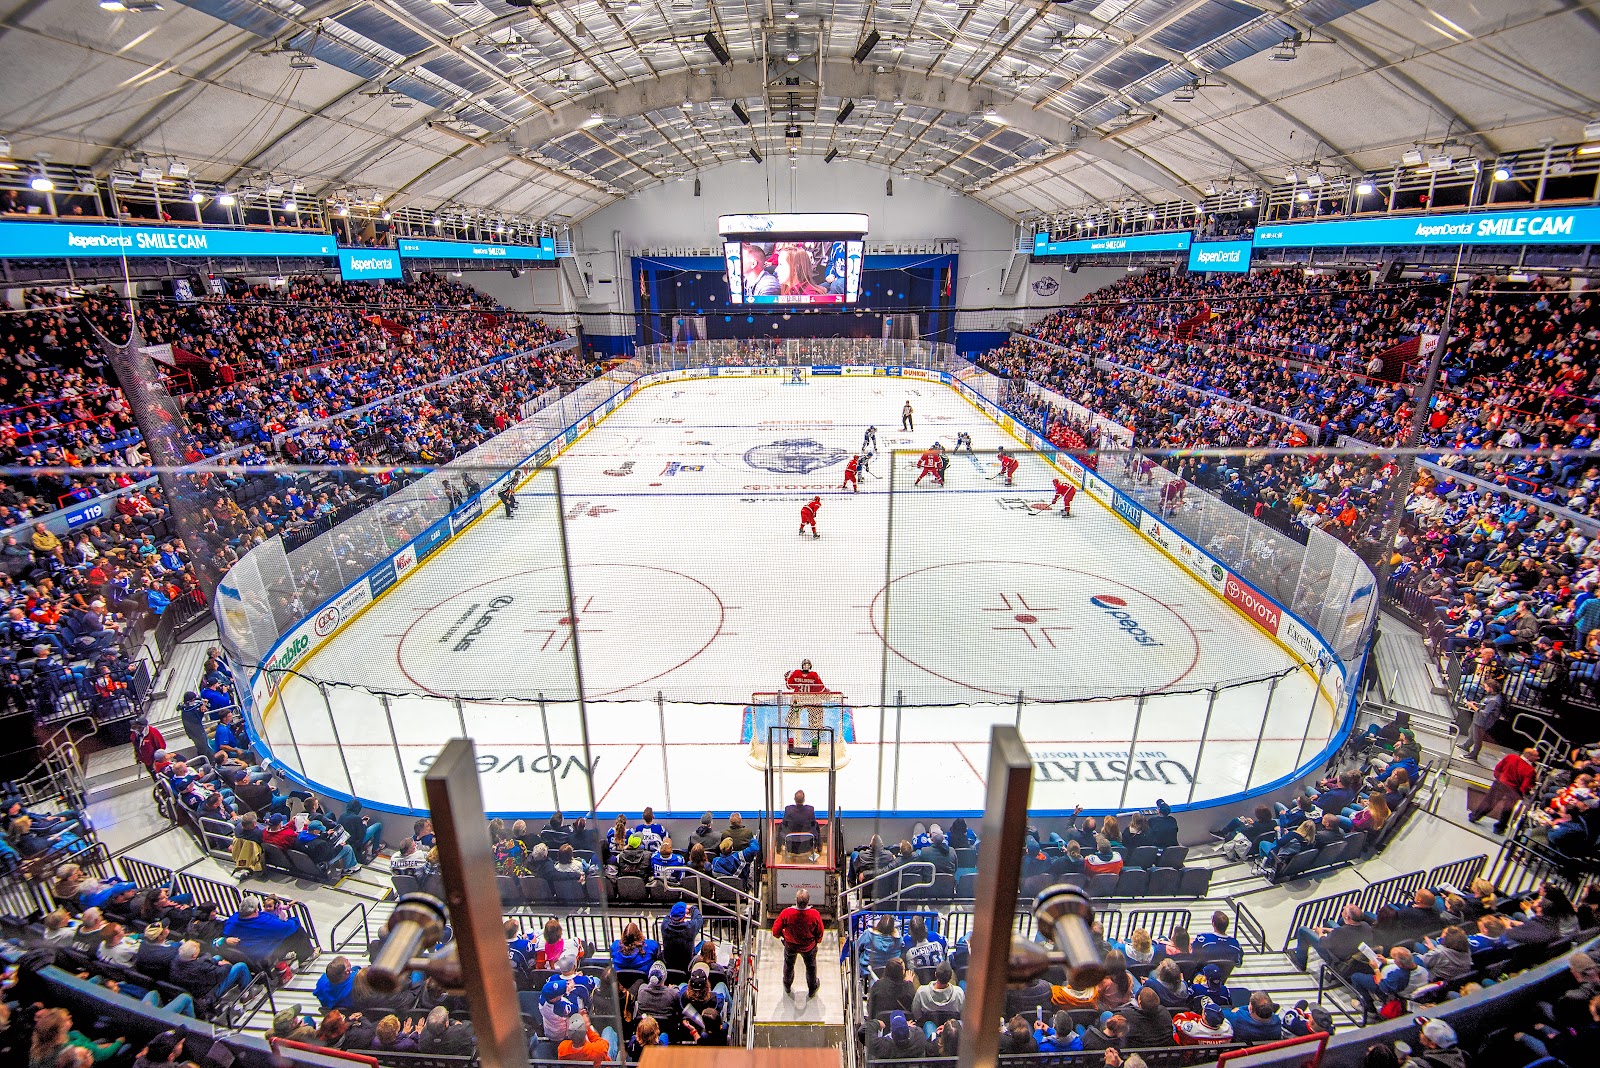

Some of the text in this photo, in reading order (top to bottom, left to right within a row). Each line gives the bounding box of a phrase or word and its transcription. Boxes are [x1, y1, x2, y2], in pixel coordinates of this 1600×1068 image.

[1415, 216, 1573, 237] AspenDental SMILE CAM
[68, 232, 207, 249] AspenDental SMILE CAM
[894, 242, 959, 255] VETERANS
[351, 256, 393, 271] AspenDental
[1197, 249, 1241, 264] AspenDental
[84, 505, 101, 519] 119
[1114, 492, 1140, 523] UPSTATE
[1240, 590, 1277, 627] TOYOTA
[1105, 611, 1163, 646] pepsi
[1287, 623, 1318, 660] Excellus
[1034, 760, 1201, 785] UPSTAT
